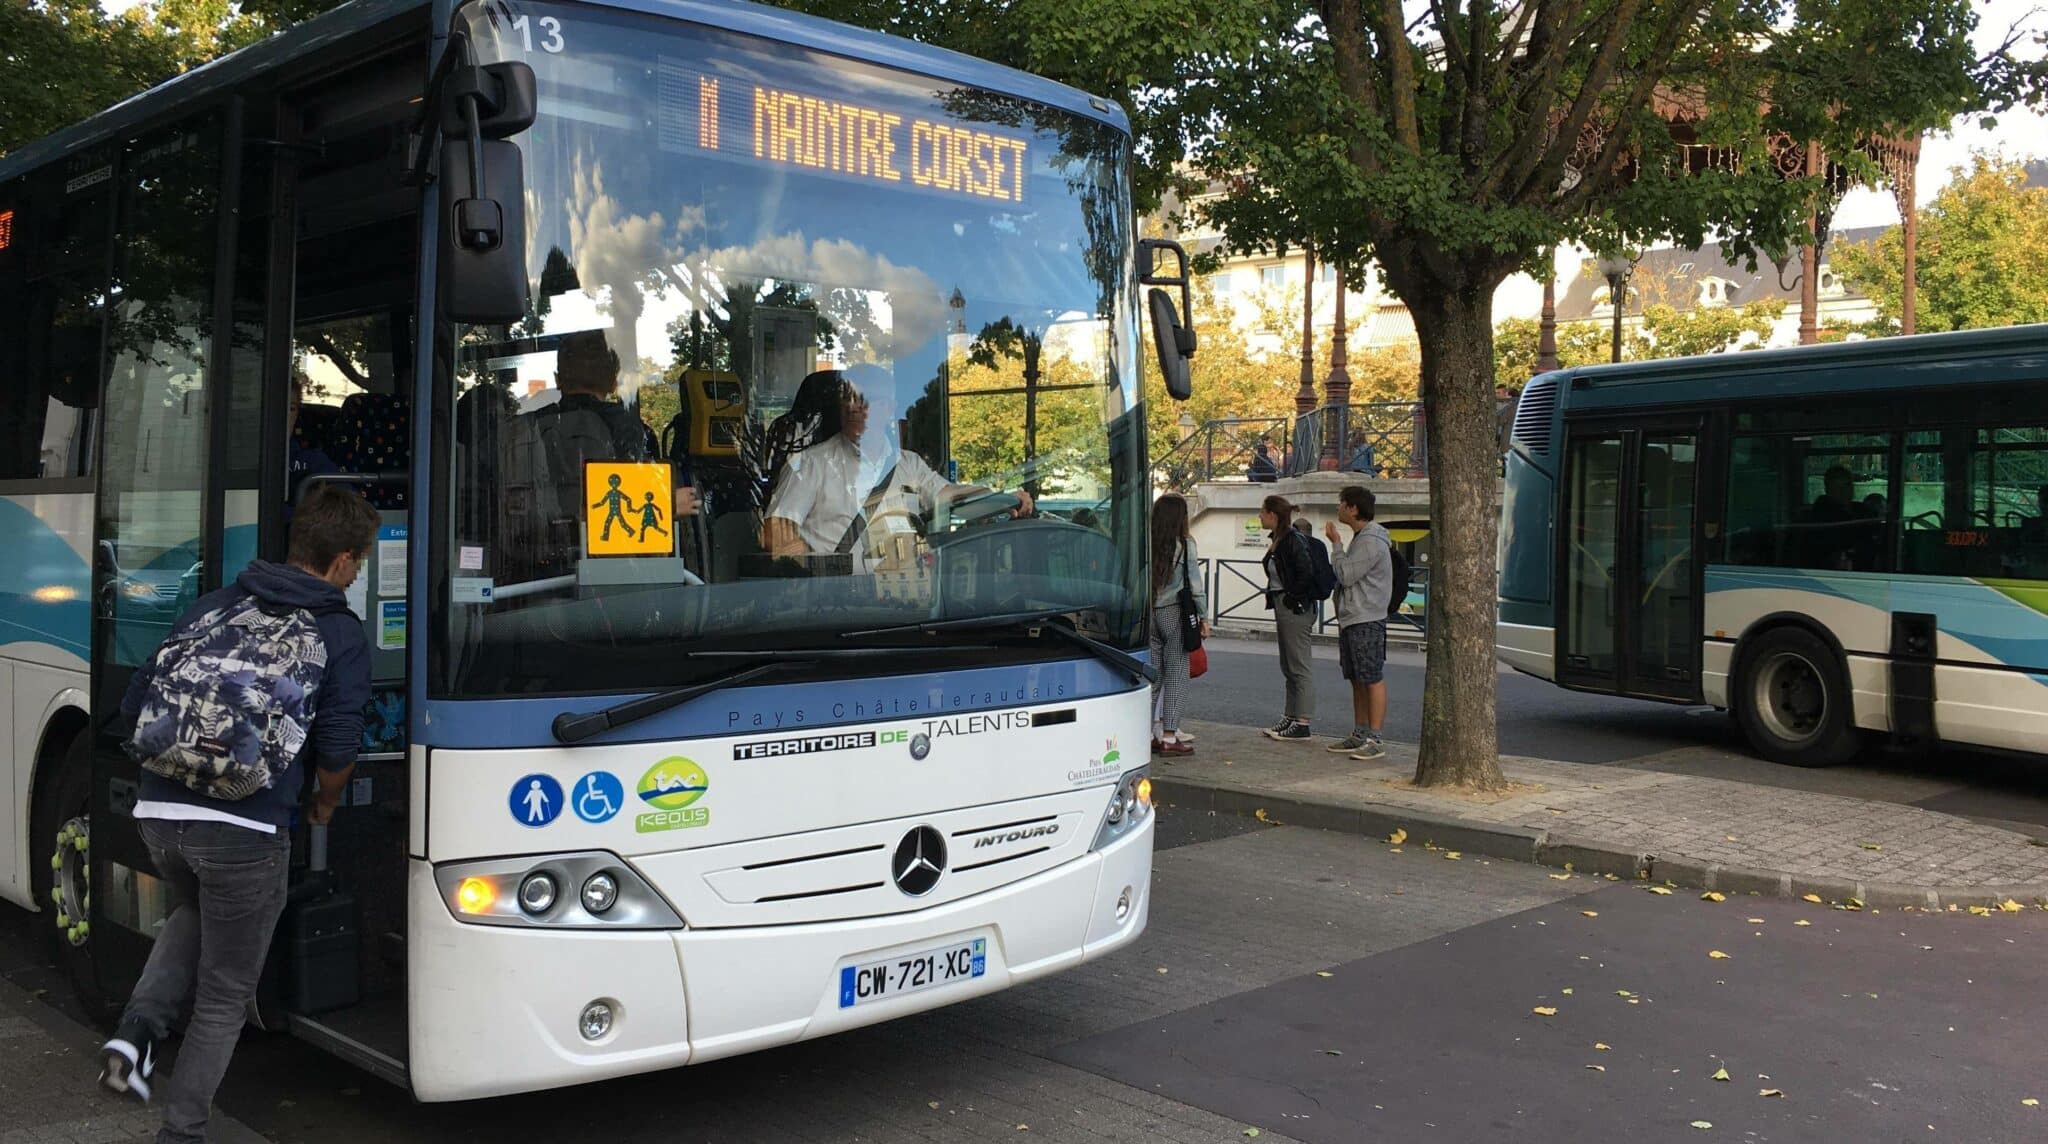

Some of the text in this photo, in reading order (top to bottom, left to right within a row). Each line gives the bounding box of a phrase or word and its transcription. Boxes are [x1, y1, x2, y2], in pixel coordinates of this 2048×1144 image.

[513, 14, 564, 53] 13
[912, 119, 1026, 201] CORSET
[728, 684, 1064, 727] Pays Châtelleraudais
[735, 710, 1030, 759] TERRITOIRE DE TALENTS
[640, 808, 706, 828] KEOLIS
[973, 824, 1060, 849] INTOURO
[972, 959, 984, 974] 86
